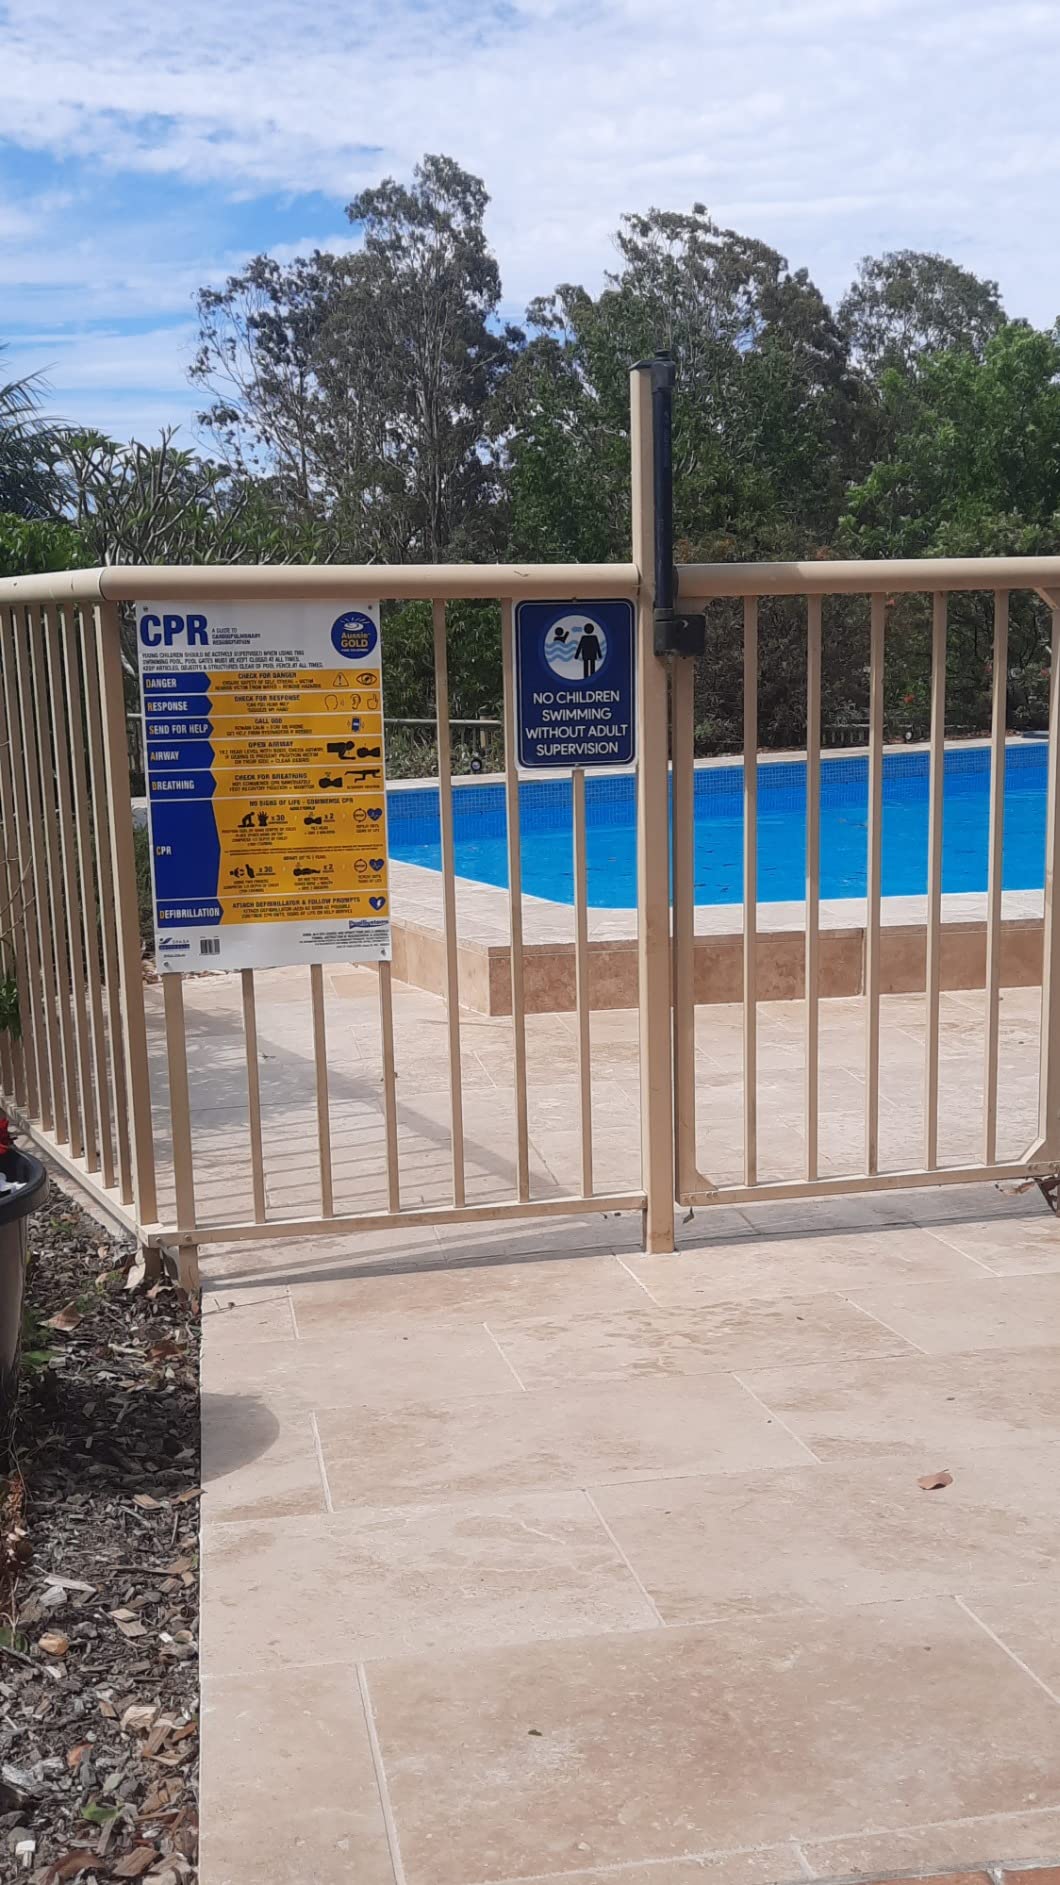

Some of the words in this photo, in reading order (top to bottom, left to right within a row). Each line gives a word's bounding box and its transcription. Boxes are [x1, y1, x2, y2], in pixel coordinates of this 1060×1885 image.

[140, 615, 209, 647] CPR
[146, 679, 177, 688] DANGER
[533, 692, 554, 704] NO
[556, 690, 620, 703] CHILDREN
[147, 701, 188, 711] RESPONSE
[542, 708, 612, 721] SWIMMING
[149, 725, 169, 735] SEND
[172, 725, 187, 734] FOR
[189, 724, 208, 733] HELP
[525, 726, 586, 739] WITHOUT
[588, 724, 628, 737] ADULT
[536, 742, 618, 756] SUPERVISION
[150, 751, 179, 760] AIRWAY
[152, 780, 194, 790] BREATHING
[156, 846, 172, 855] CPR
[160, 908, 220, 919] DEFIBRILLATION
